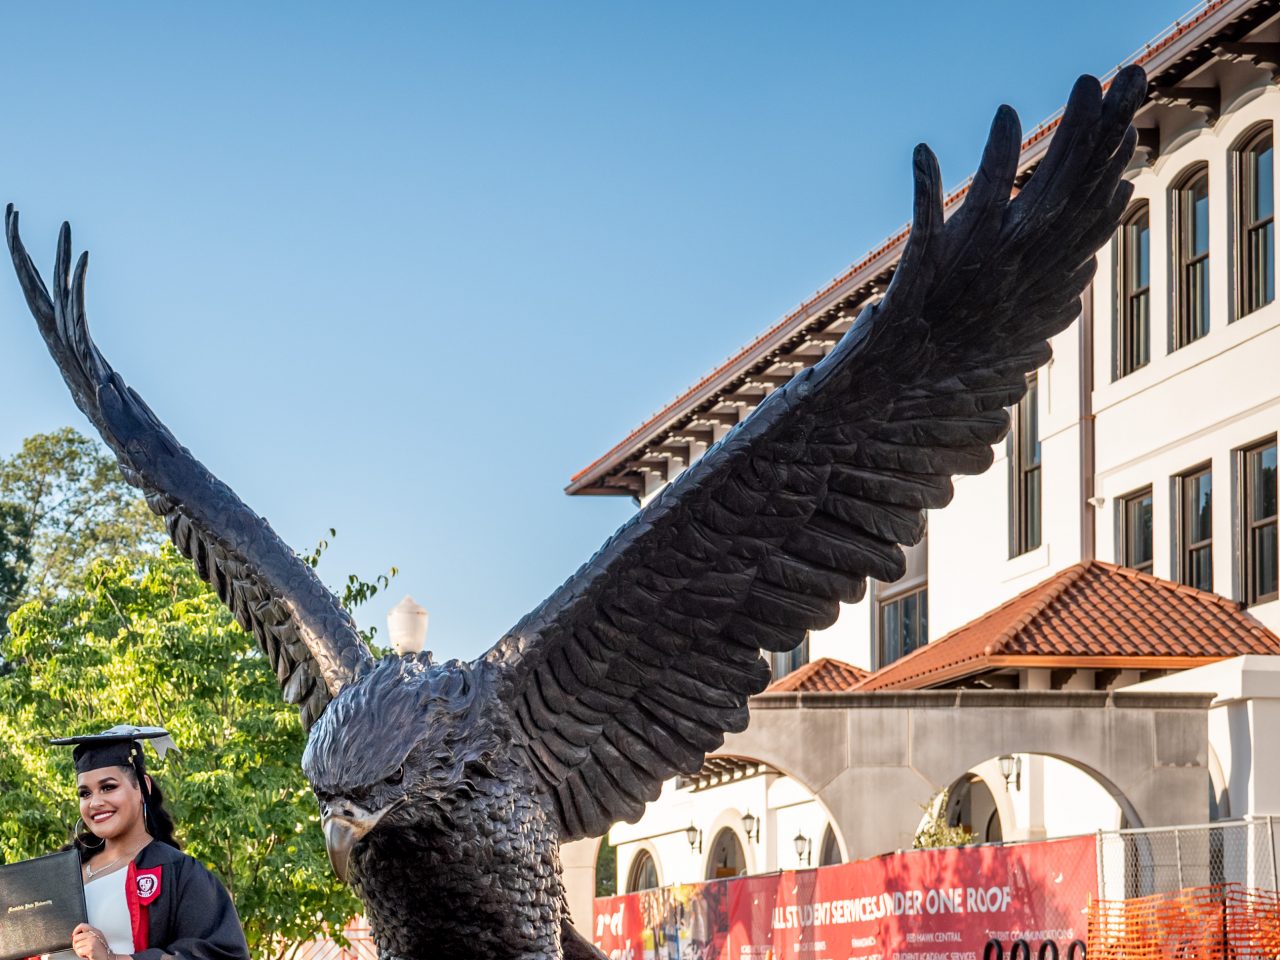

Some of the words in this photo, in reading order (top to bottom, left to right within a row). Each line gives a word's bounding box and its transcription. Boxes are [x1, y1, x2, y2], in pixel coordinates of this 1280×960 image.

[786, 902, 831, 928] STUDENT
[832, 896, 877, 924] SERVICES
[926, 887, 963, 914] ONE
[967, 886, 1011, 912] ROOF
[917, 932, 934, 942] HAWK
[935, 931, 962, 942] CENTRAL
